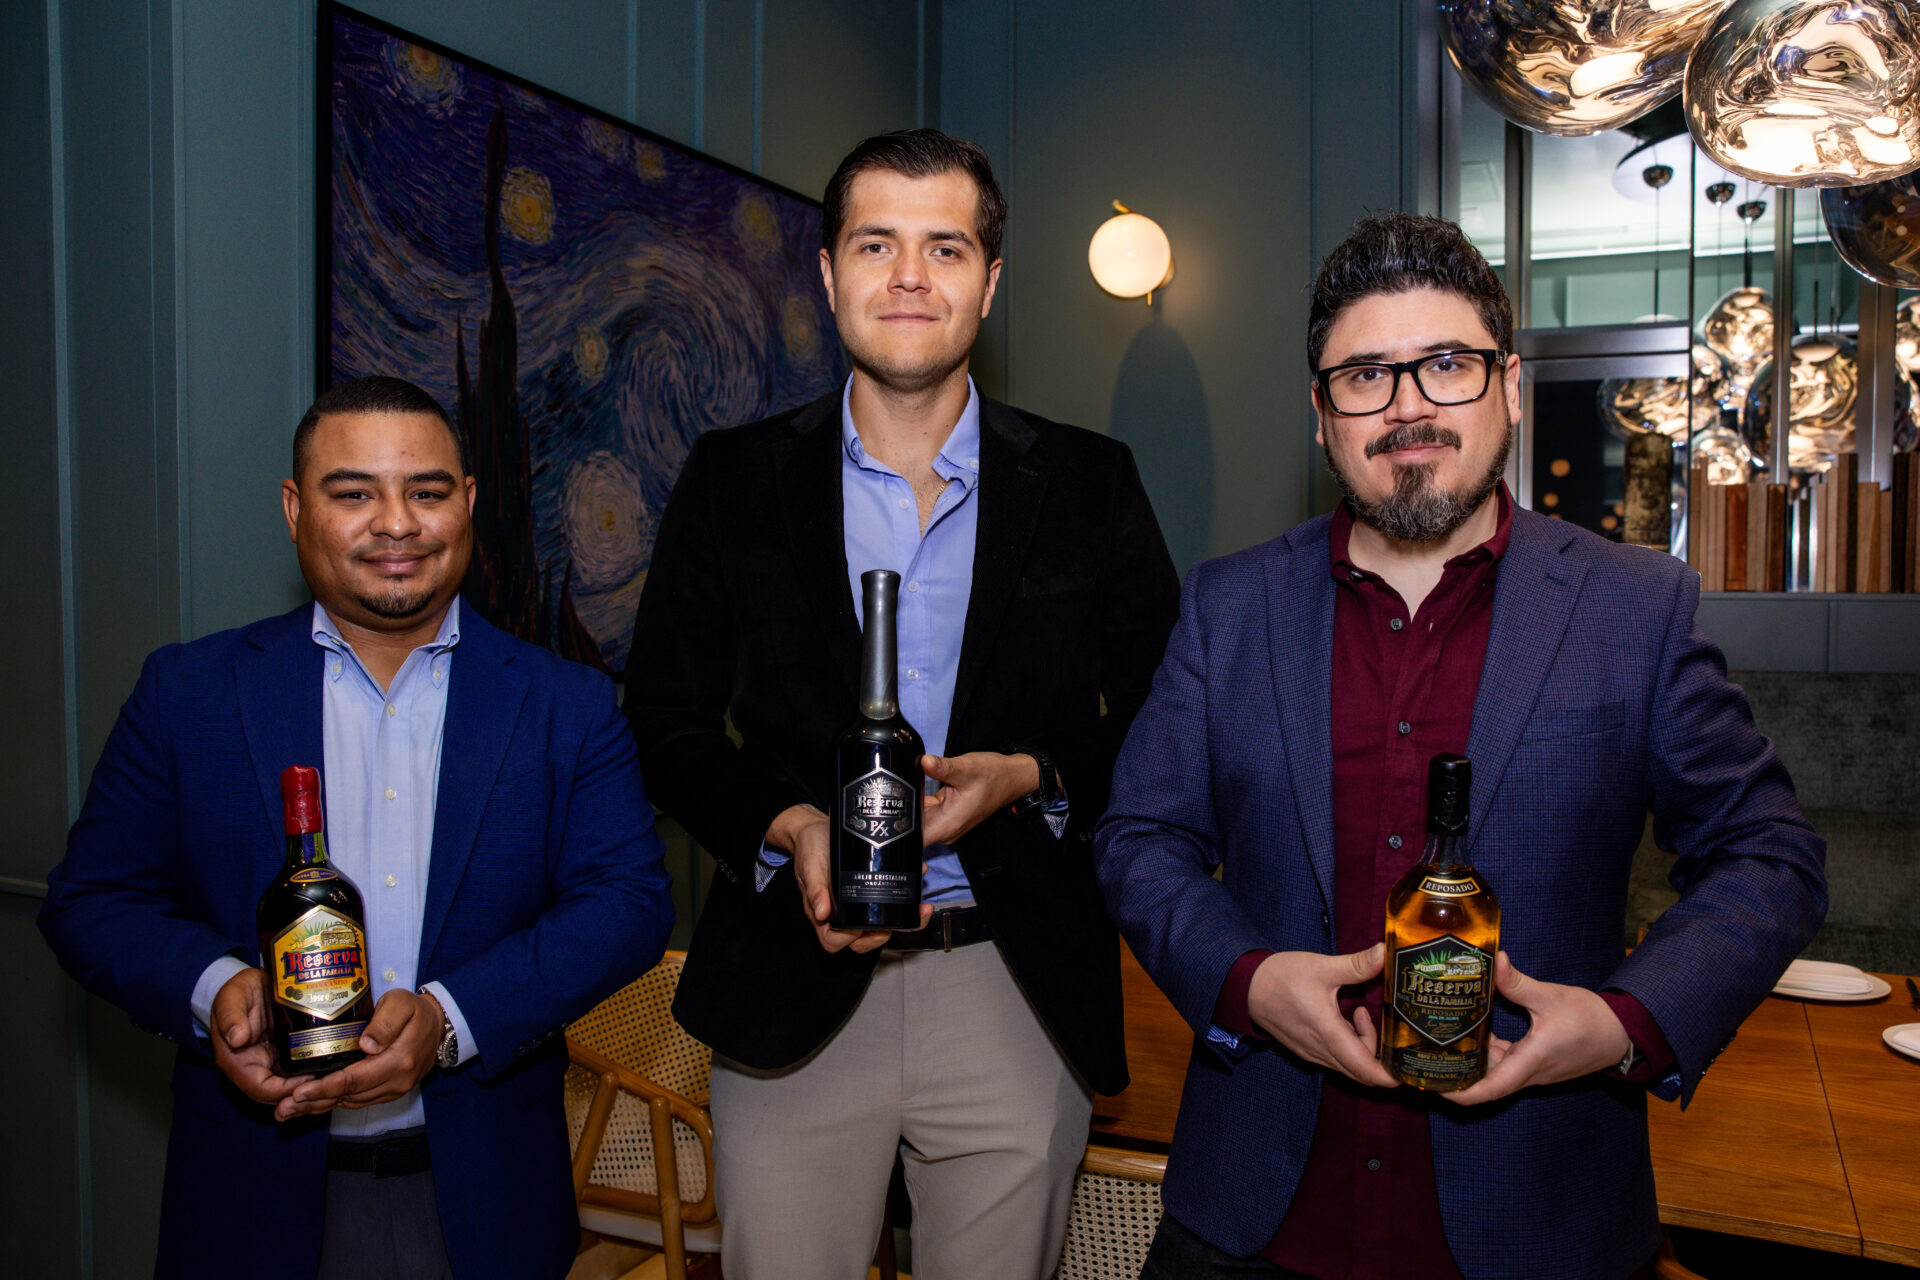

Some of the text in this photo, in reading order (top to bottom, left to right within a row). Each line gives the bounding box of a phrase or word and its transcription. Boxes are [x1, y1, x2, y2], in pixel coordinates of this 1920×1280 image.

[856, 795, 904, 809] Reserva
[1425, 881, 1474, 893] REPOSADO
[287, 949, 359, 973] Reserva
[298, 971, 310, 981] DE
[310, 969, 321, 979] LA
[321, 966, 353, 978] FAMILIA
[1407, 971, 1482, 995] Reserva
[1417, 994, 1428, 1003] DE
[1428, 995, 1440, 1005] LA
[1440, 995, 1473, 1006] FAMILIA
[1421, 1008, 1467, 1017] REPOSADO
